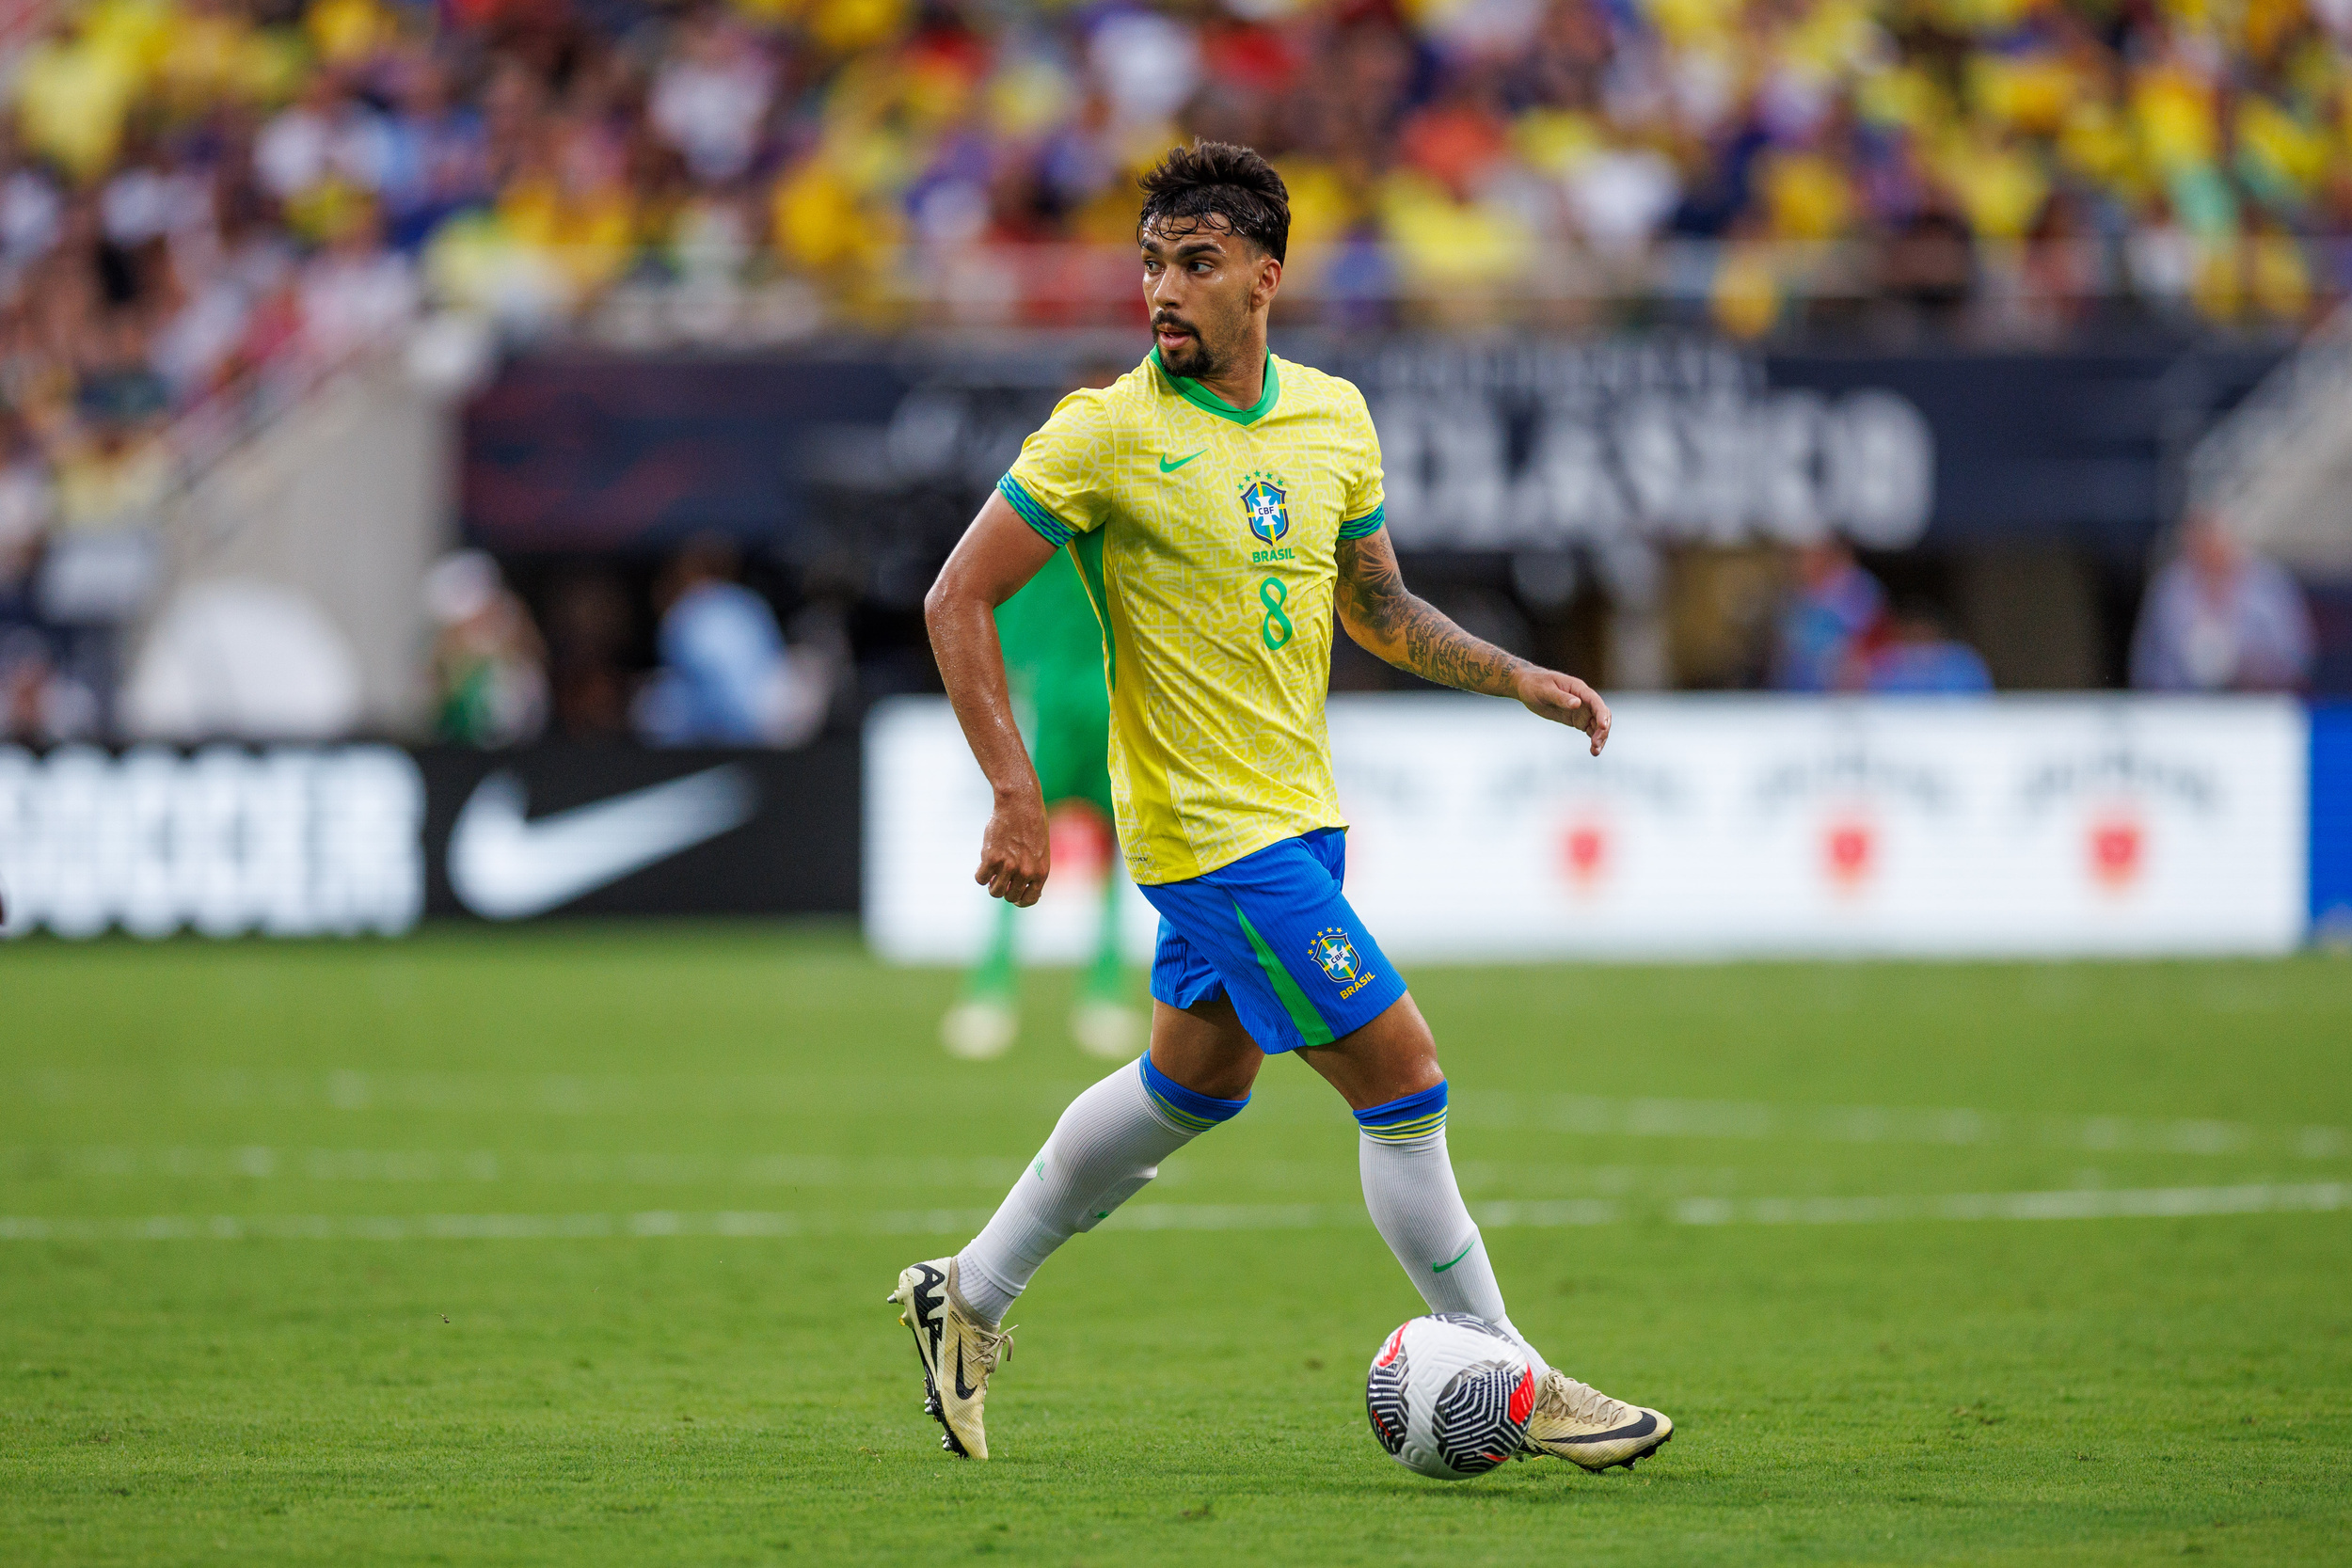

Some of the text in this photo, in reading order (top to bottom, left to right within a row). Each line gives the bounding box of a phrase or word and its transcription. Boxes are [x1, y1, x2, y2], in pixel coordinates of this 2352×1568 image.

[1258, 506, 1275, 515] CBF
[1252, 547, 1295, 562] BRASIL
[1260, 577, 1293, 651] 8
[1330, 951, 1344, 964] CBF
[1340, 972, 1375, 1000] BRASIL
